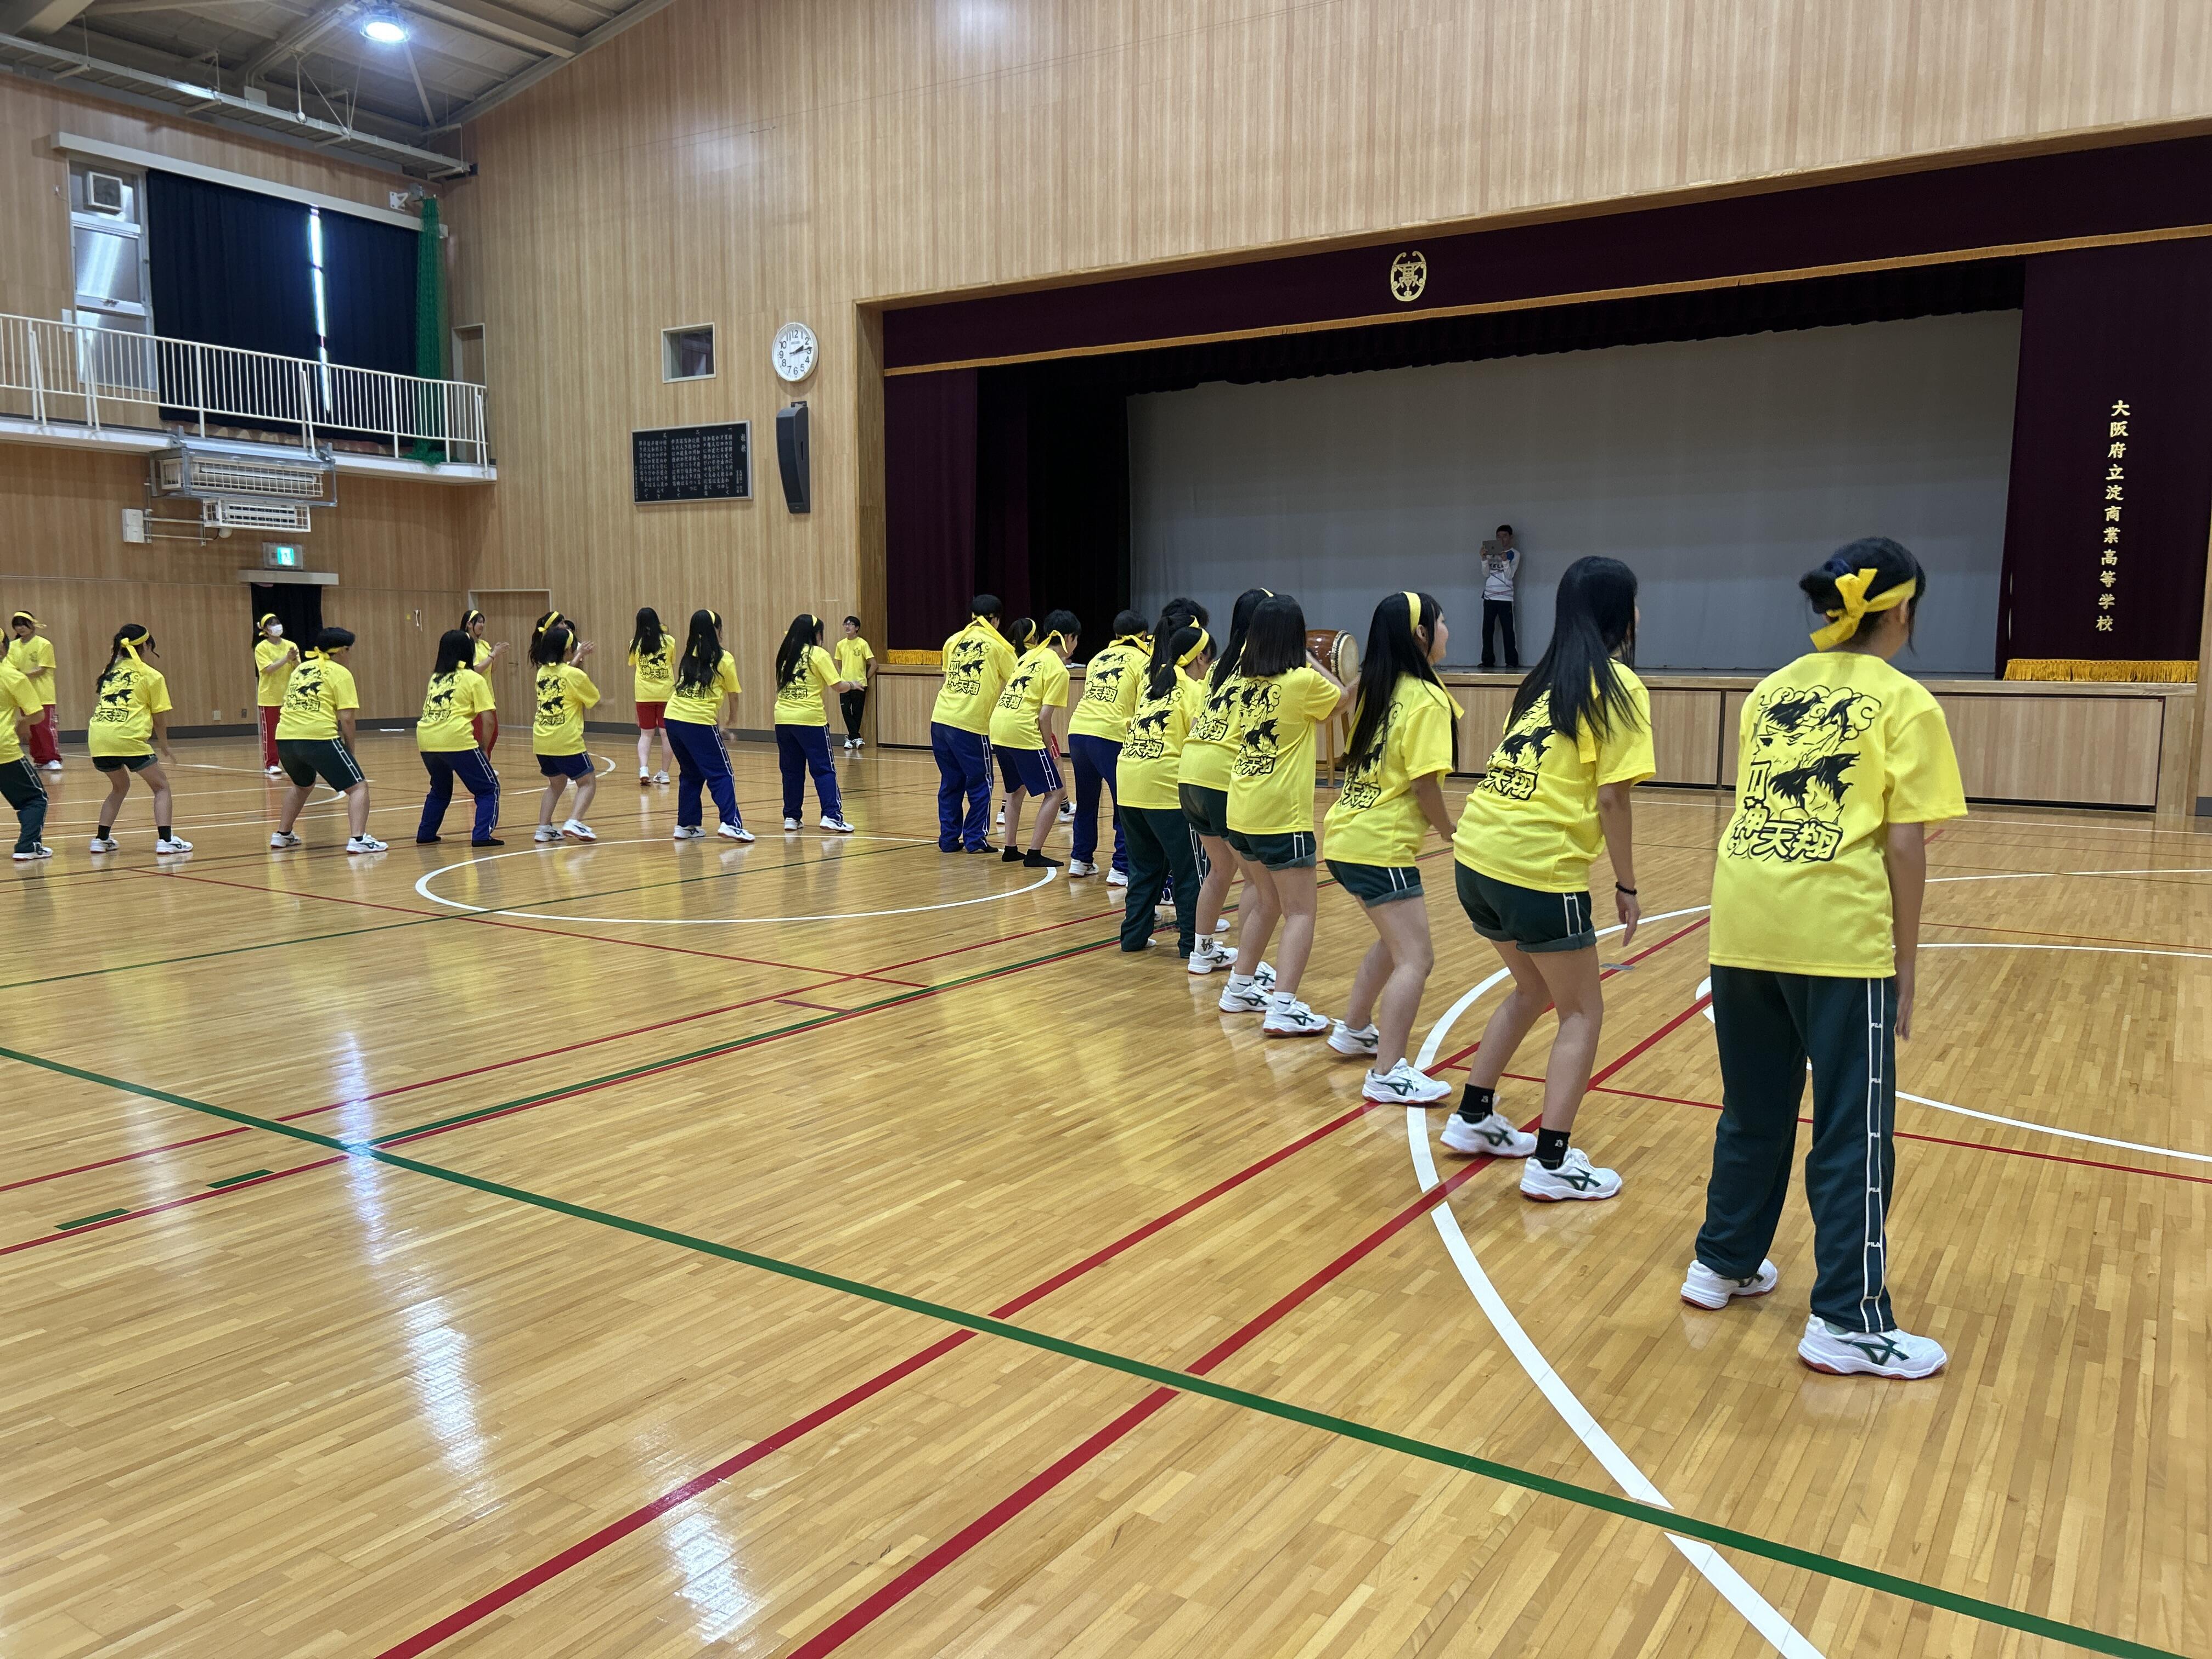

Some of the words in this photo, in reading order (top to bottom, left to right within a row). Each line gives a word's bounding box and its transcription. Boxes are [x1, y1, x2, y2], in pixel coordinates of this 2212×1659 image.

[786, 332, 791, 341] 11
[805, 337, 809, 345] 2
[780, 341, 787, 349] 10
[780, 351, 784, 359] 9
[782, 359, 787, 367] 8
[793, 366, 798, 375] 6
[800, 364, 805, 372] 5
[2095, 399, 2130, 631] 大阪府立淀商業高等学校
[955, 680, 980, 695] 天翔
[1087, 686, 1118, 703] 天翔
[1001, 695, 1023, 709] 天翔
[98, 708, 129, 722] 天翔
[1751, 817, 1844, 861] 天翔
